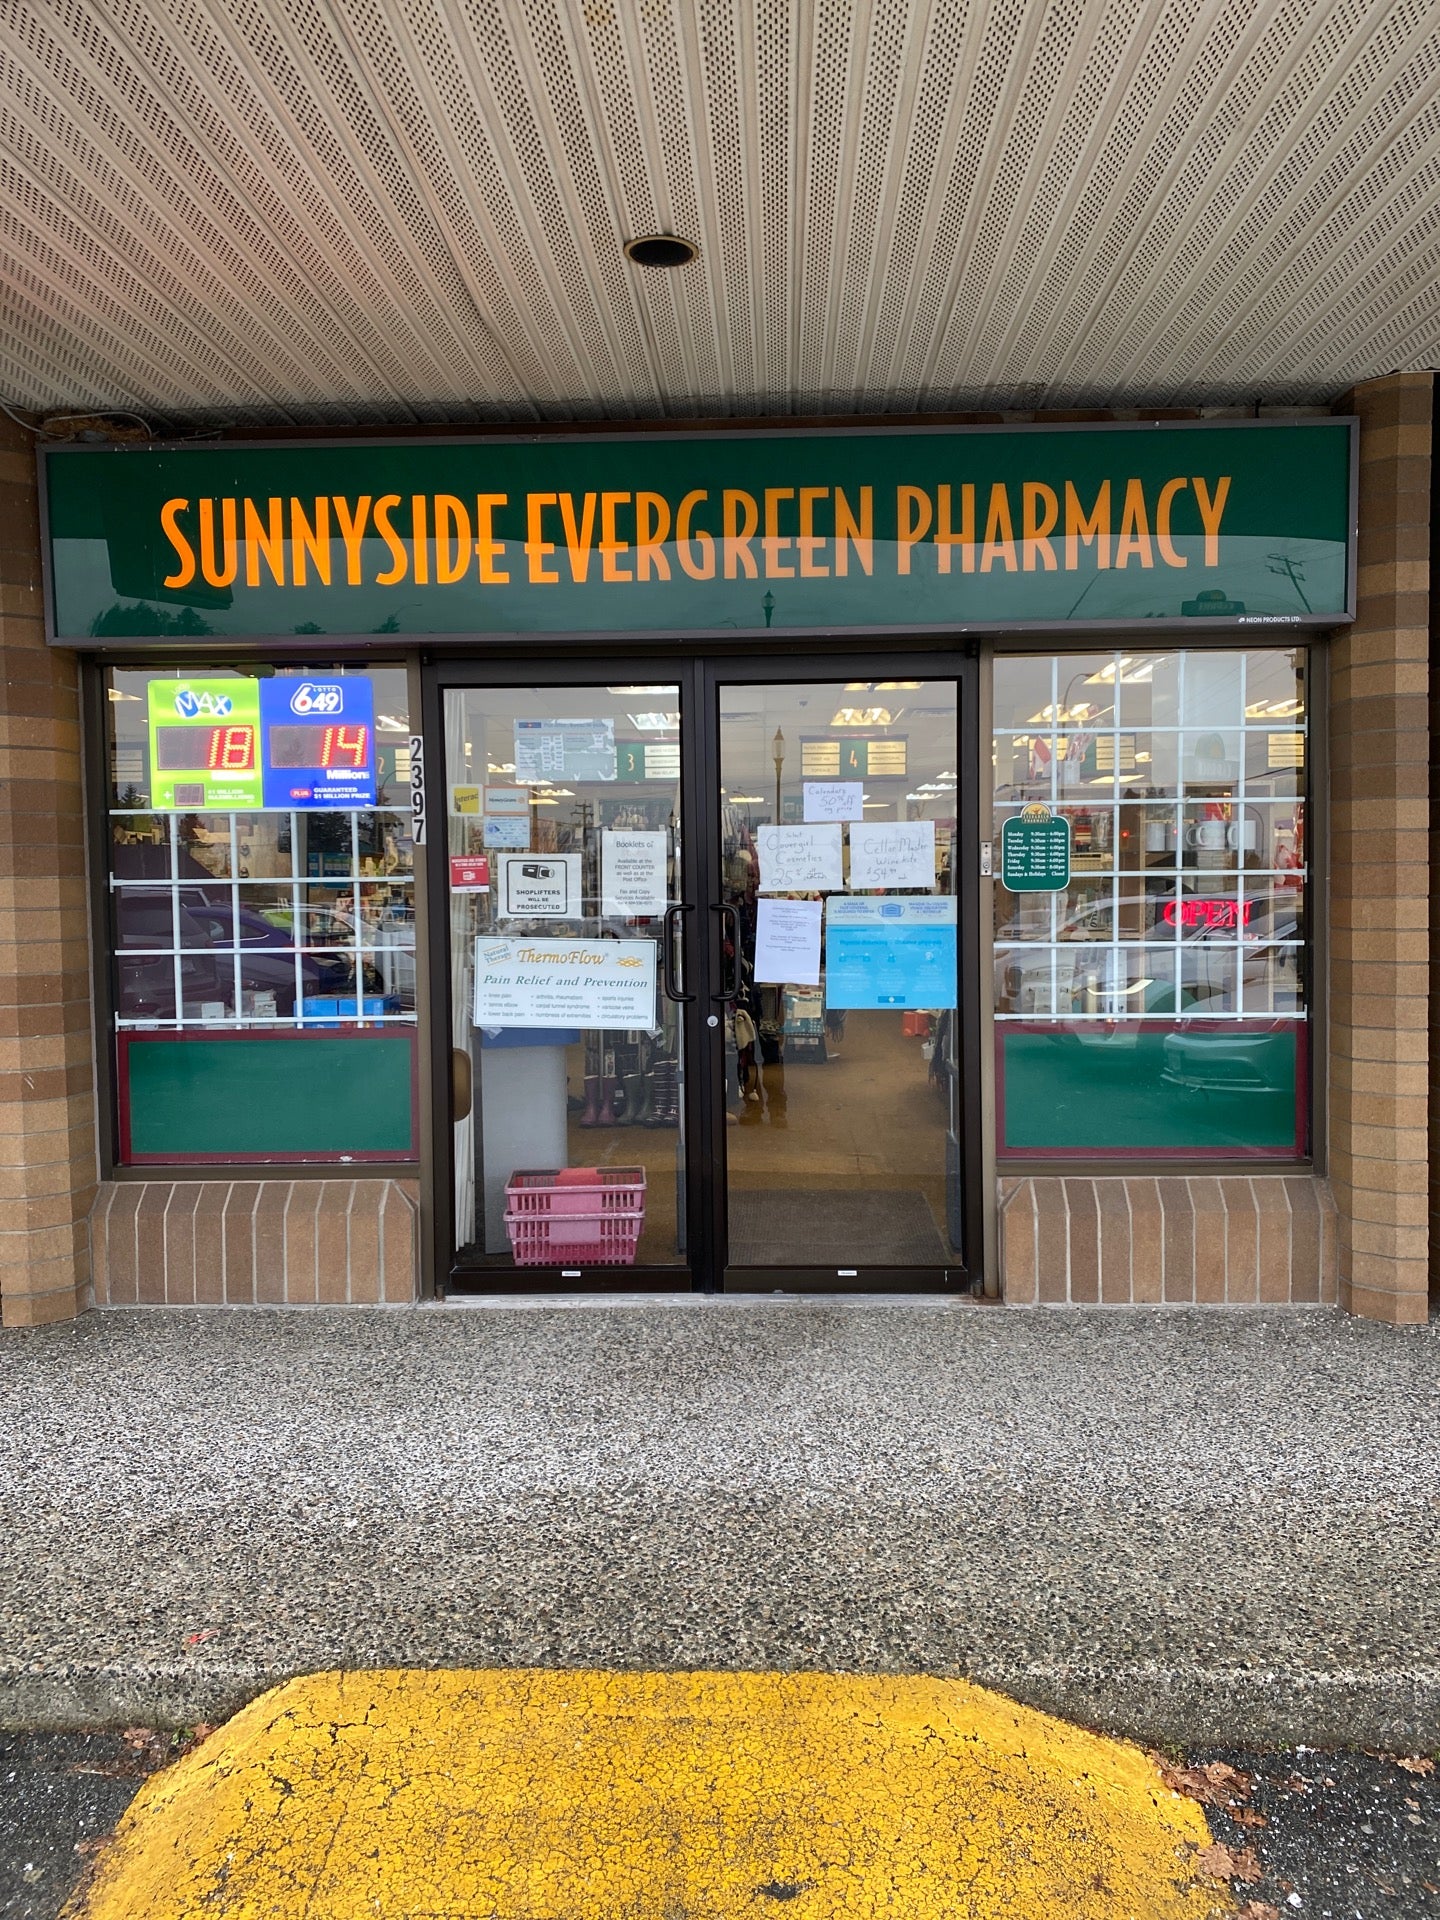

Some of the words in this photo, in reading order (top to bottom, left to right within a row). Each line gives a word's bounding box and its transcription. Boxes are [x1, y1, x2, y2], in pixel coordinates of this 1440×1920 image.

[160, 493, 510, 588] SUNNYSIDE
[524, 486, 874, 583] EVERGREEN
[896, 476, 1232, 576] PHARMACY
[175, 690, 230, 718] MAX
[208, 726, 253, 768] 18
[321, 726, 366, 767] 14
[627, 753, 635, 771] 3
[850, 750, 858, 768] 4
[615, 840, 645, 848] Booklets
[775, 850, 823, 865] Cosmetics
[1163, 900, 1254, 927] OPEN
[483, 945, 509, 958] Natural
[485, 951, 511, 965] Therapy
[483, 975, 511, 985] Pain
[515, 975, 553, 986] Relief
[556, 977, 579, 987] and
[584, 977, 648, 988] Prevention
